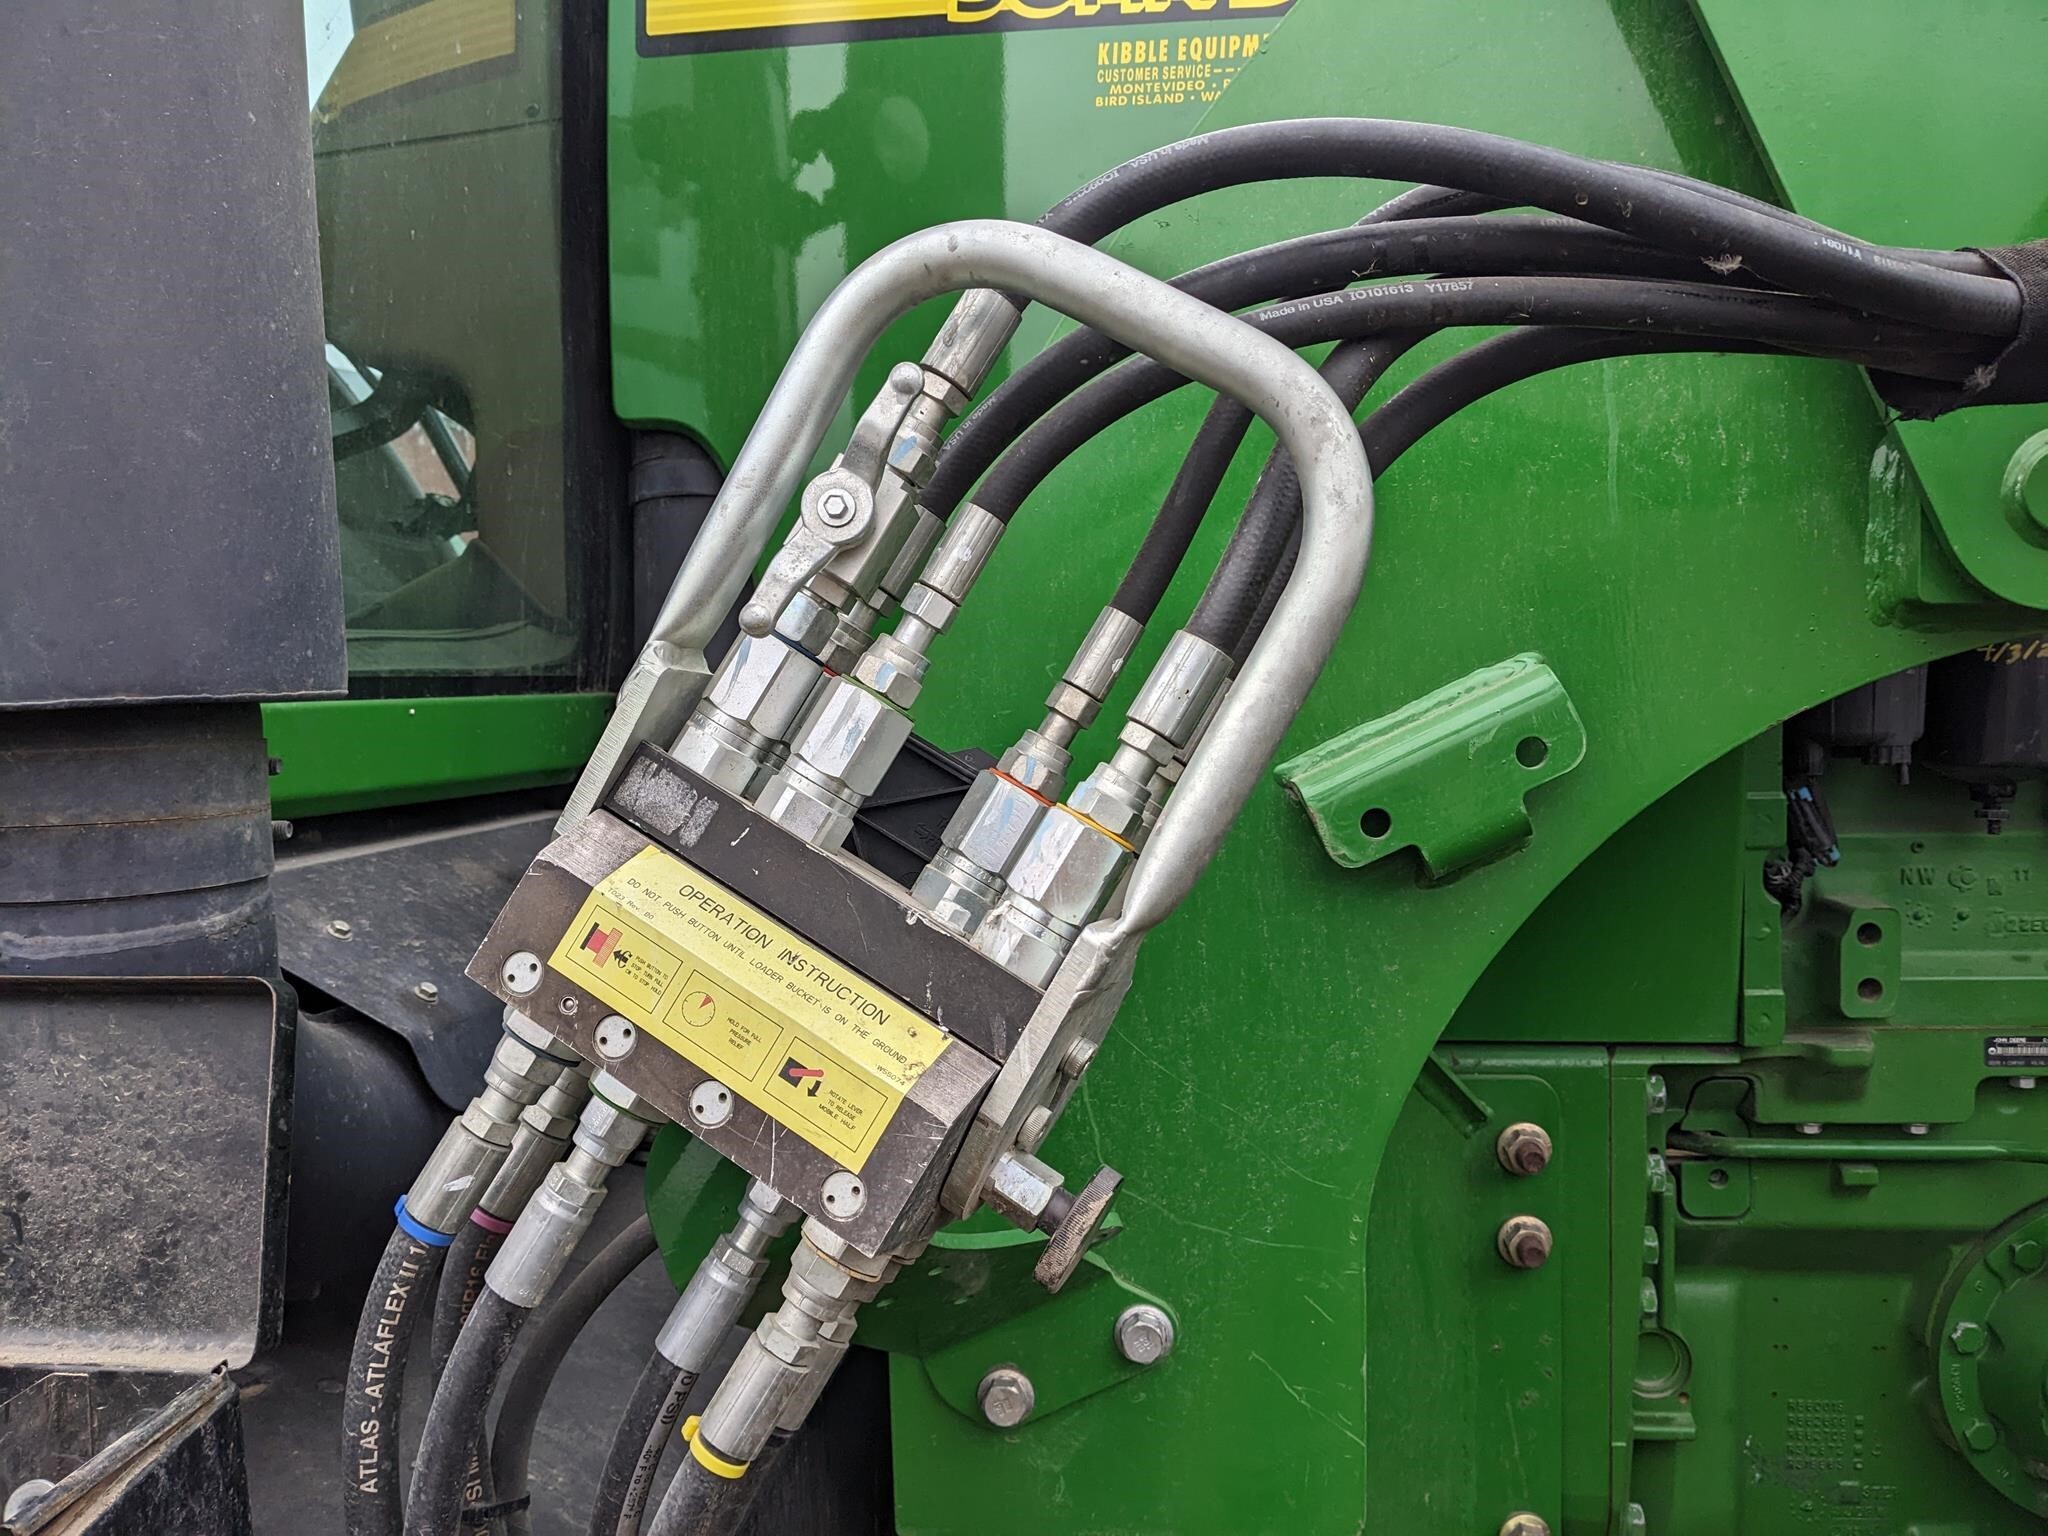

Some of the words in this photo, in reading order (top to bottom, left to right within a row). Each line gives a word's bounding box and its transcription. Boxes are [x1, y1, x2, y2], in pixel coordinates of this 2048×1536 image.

[1097, 39, 1169, 65] KIBBLE
[1097, 66, 1159, 83] CUSTOMER
[1109, 80, 1205, 94] MONTEVIDEO
[1095, 95, 1128, 107] BIRD
[1132, 92, 1185, 105] ISLAND
[1130, 152, 1158, 168] USA
[1259, 306, 1295, 321] Made
[1299, 302, 1310, 312] in
[1313, 295, 1343, 308] USA
[971, 395, 998, 420] Made
[962, 420, 972, 429] in
[942, 430, 964, 450] USA
[626, 877, 642, 889] DO
[641, 887, 662, 902] NOT
[662, 901, 687, 919] PUSH
[687, 917, 722, 942] BUTTON
[722, 940, 746, 960] UNTIL
[749, 958, 784, 983] LOADER
[785, 981, 821, 1007] BUCKET
[821, 1004, 832, 1015] IS
[834, 1013, 849, 1025] ON
[851, 1024, 871, 1040] THE
[678, 884, 774, 949] OPERATION
[776, 948, 891, 1026] INSTRUCTION
[727, 1017, 739, 1028] HOLD
[818, 1103, 839, 1120] MOBILE
[829, 1089, 847, 1105] ROTATE
[847, 1102, 863, 1116] LEVER
[835, 1104, 856, 1121] RELEASE
[365, 1281, 412, 1399] ATLAFLEX
[359, 1418, 380, 1494] ATLAS
